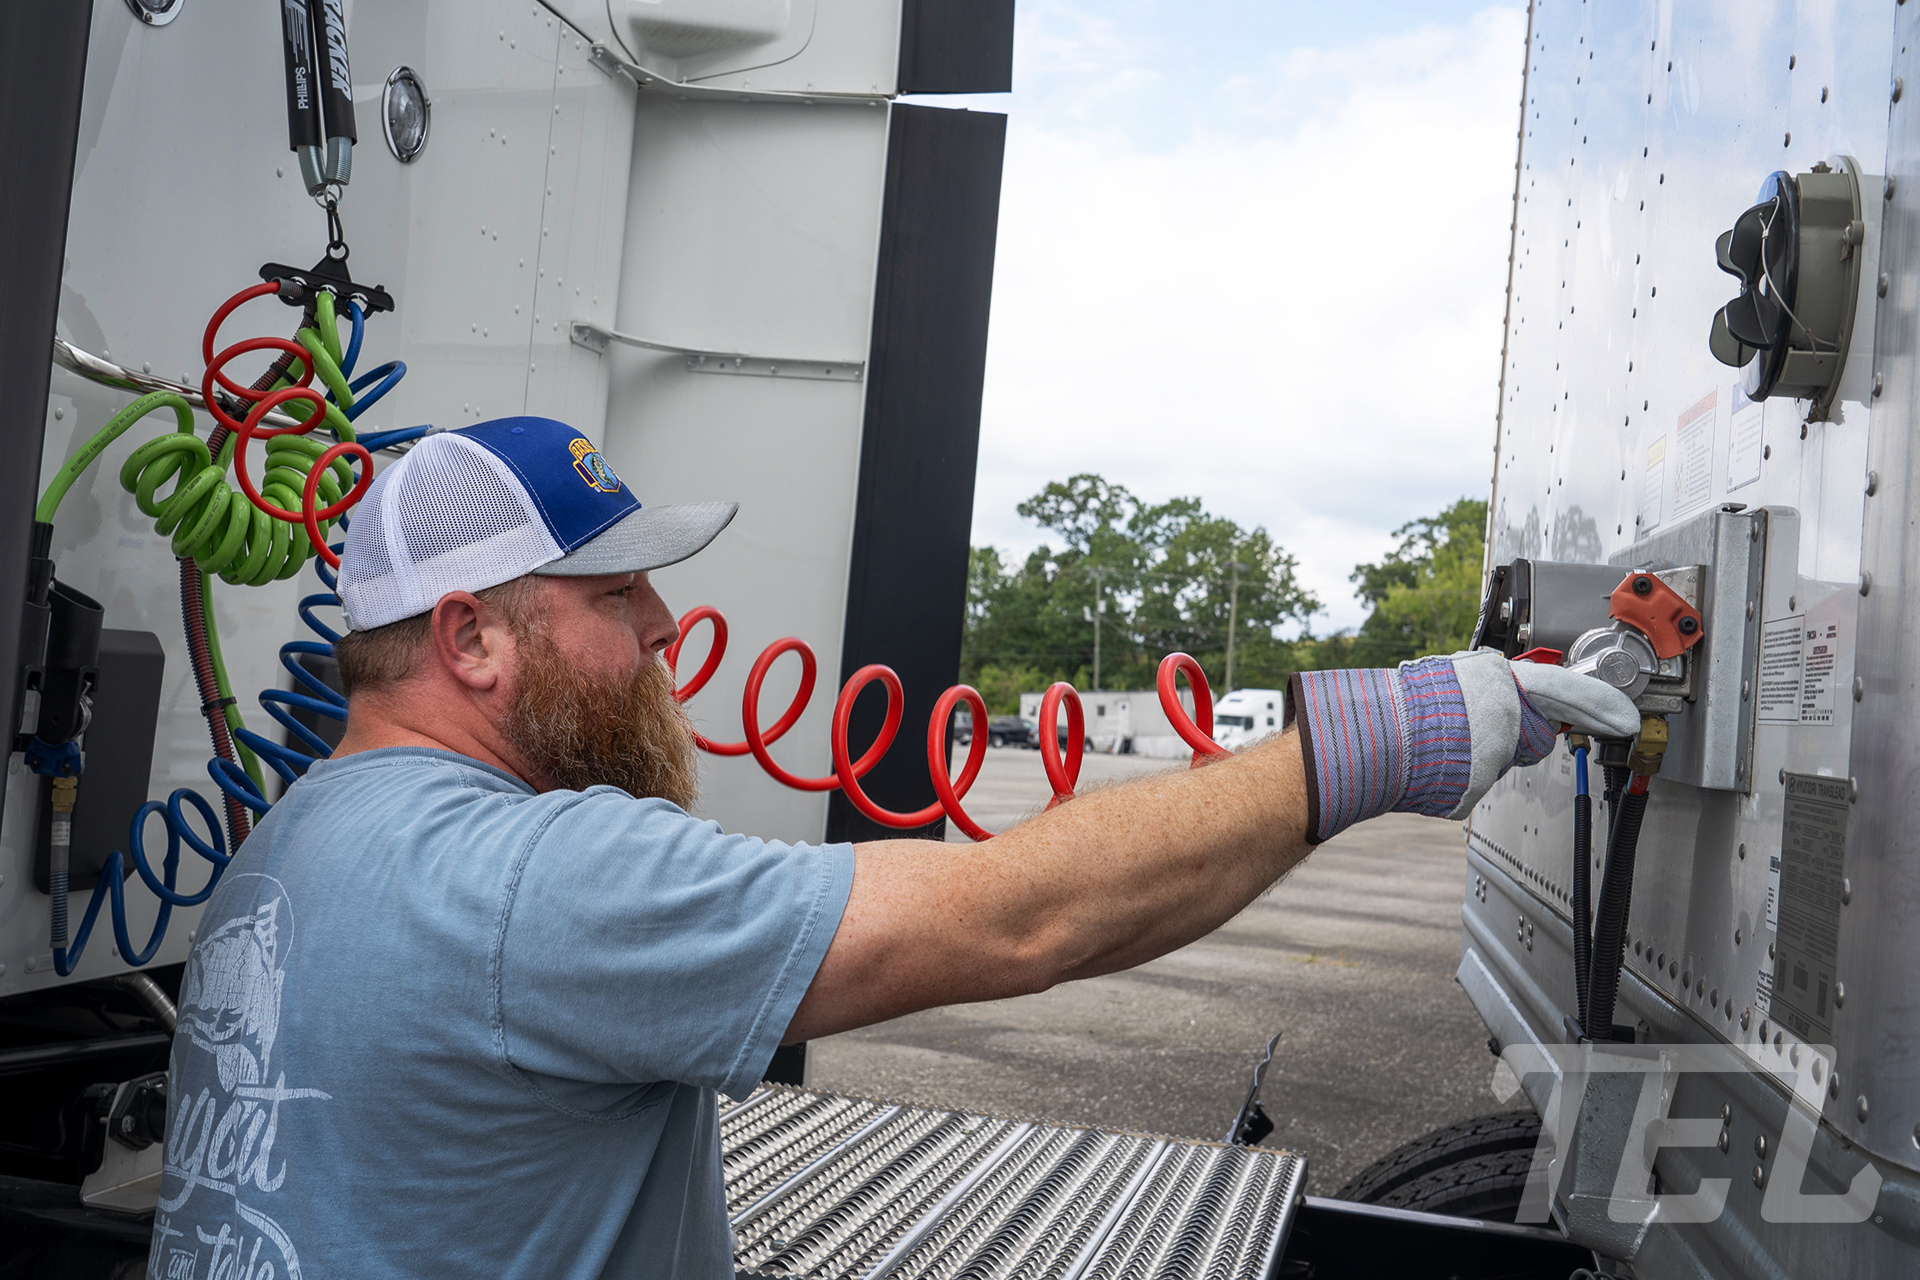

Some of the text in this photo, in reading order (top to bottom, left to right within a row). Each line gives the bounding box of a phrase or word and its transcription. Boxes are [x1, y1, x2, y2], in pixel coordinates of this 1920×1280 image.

[295, 66, 309, 109] PHILLIPS
[1796, 779, 1846, 800] HYUNDAI TRANSLEAD
